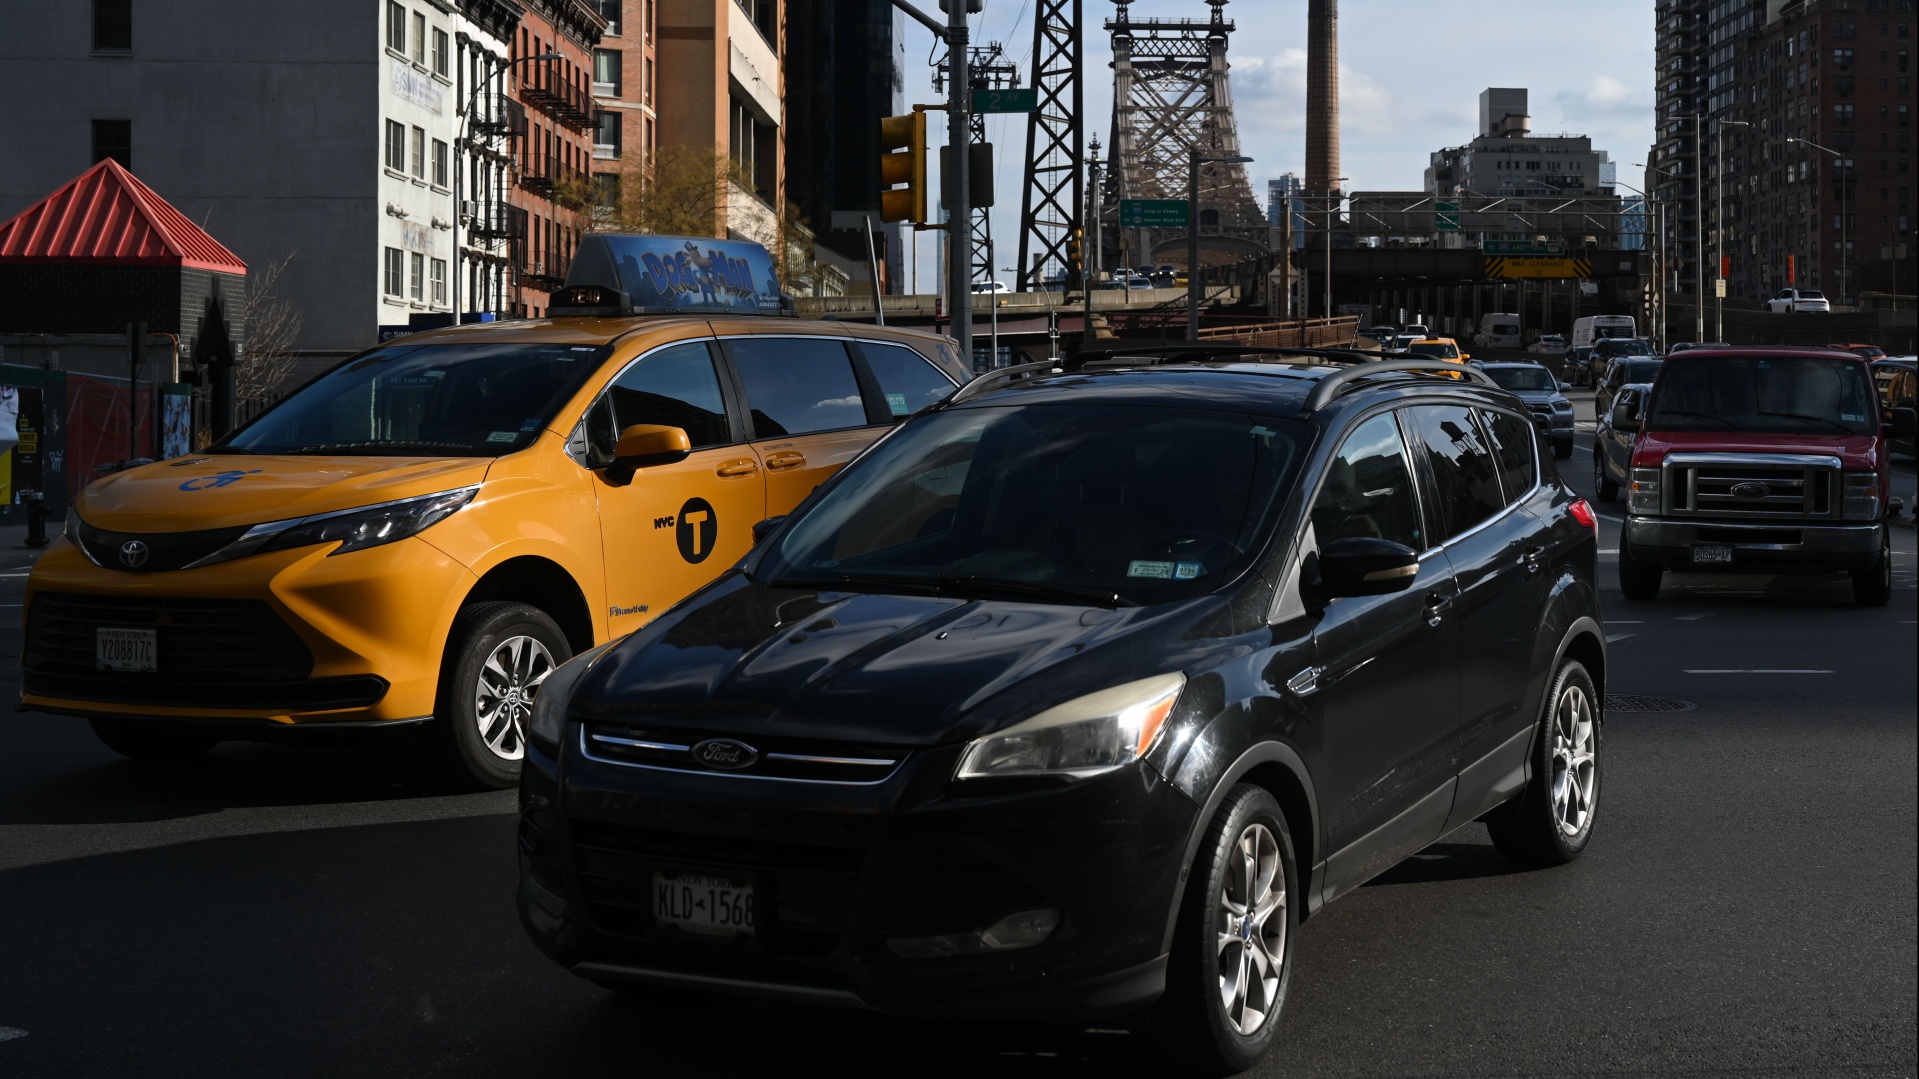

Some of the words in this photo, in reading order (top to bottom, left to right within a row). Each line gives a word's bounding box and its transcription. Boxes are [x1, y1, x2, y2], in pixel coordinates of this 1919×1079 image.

[989, 92, 1001, 110] 2
[1006, 92, 1019, 102] AV
[641, 250, 698, 300] DOG
[708, 249, 756, 299] MAN
[571, 288, 600, 305] 7E40
[653, 516, 675, 529] NYC
[101, 639, 152, 662] Y208817C
[703, 742, 741, 762] Ford
[679, 874, 702, 886] NEW
[659, 883, 693, 919] KLD
[709, 889, 754, 927] 1568
